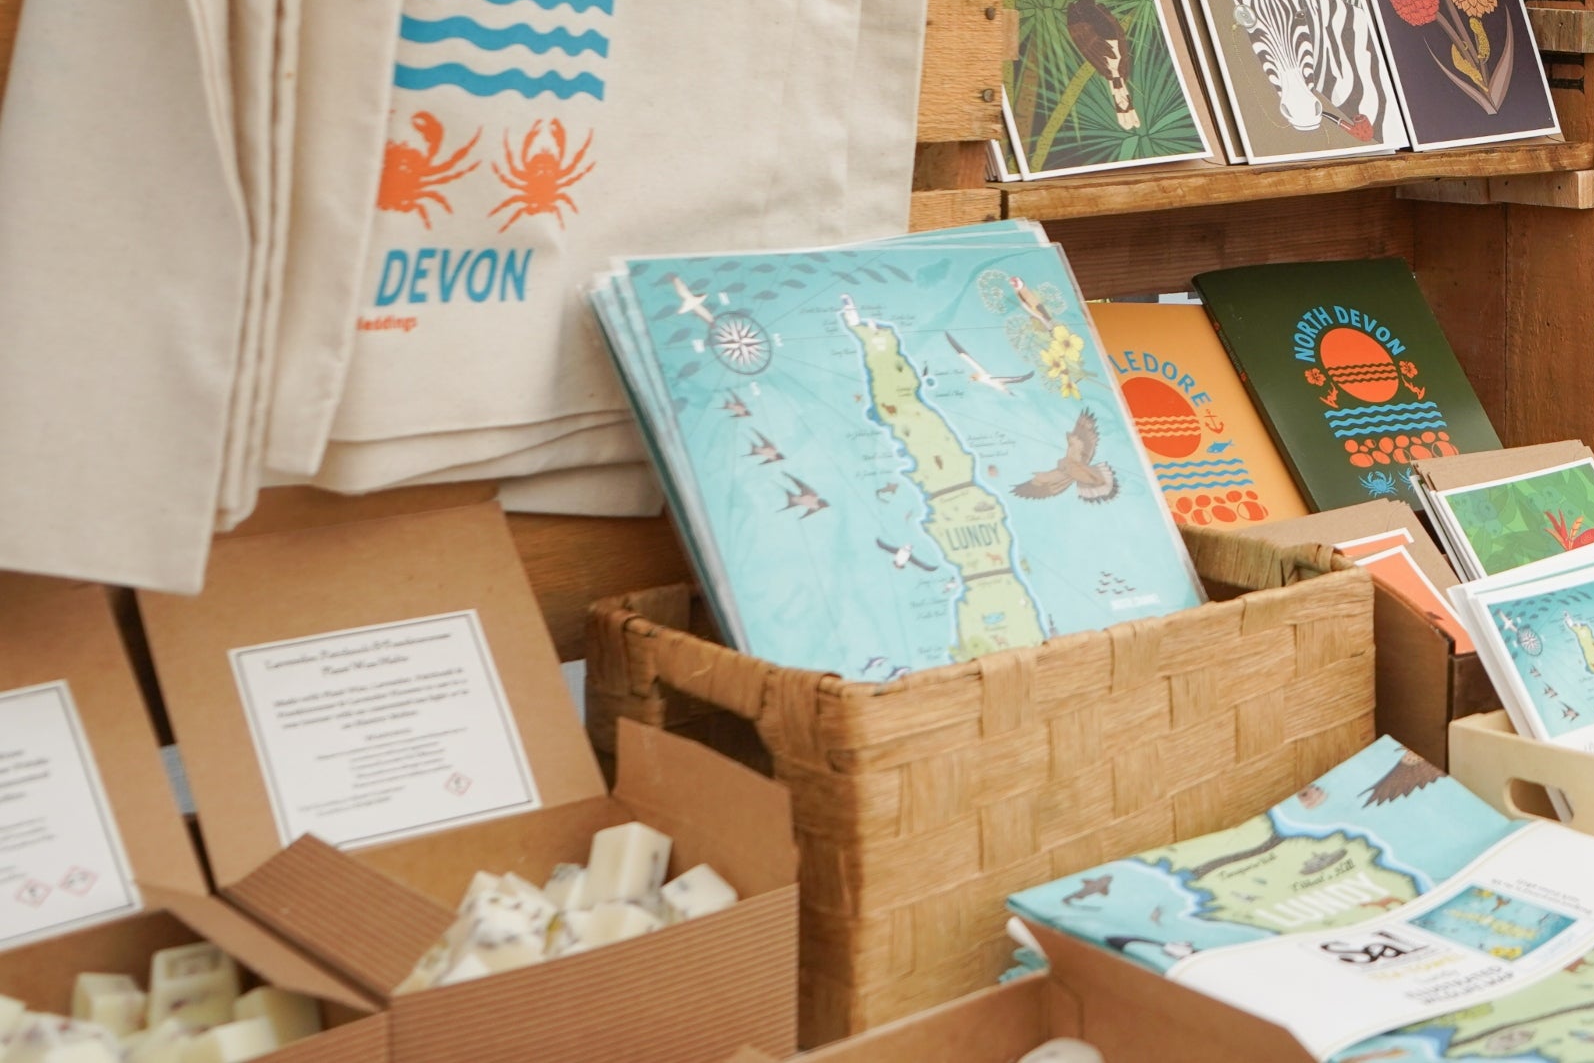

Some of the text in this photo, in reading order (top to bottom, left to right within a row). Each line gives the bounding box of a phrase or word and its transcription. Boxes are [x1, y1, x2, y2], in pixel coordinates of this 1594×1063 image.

[374, 248, 533, 307] DEVON
[1294, 306, 1334, 364] NORTH
[1333, 304, 1407, 357] DEVON
[945, 522, 1003, 551] LUNDY
[1254, 872, 1391, 927] LUNDY
[1320, 931, 1431, 964] Sal
